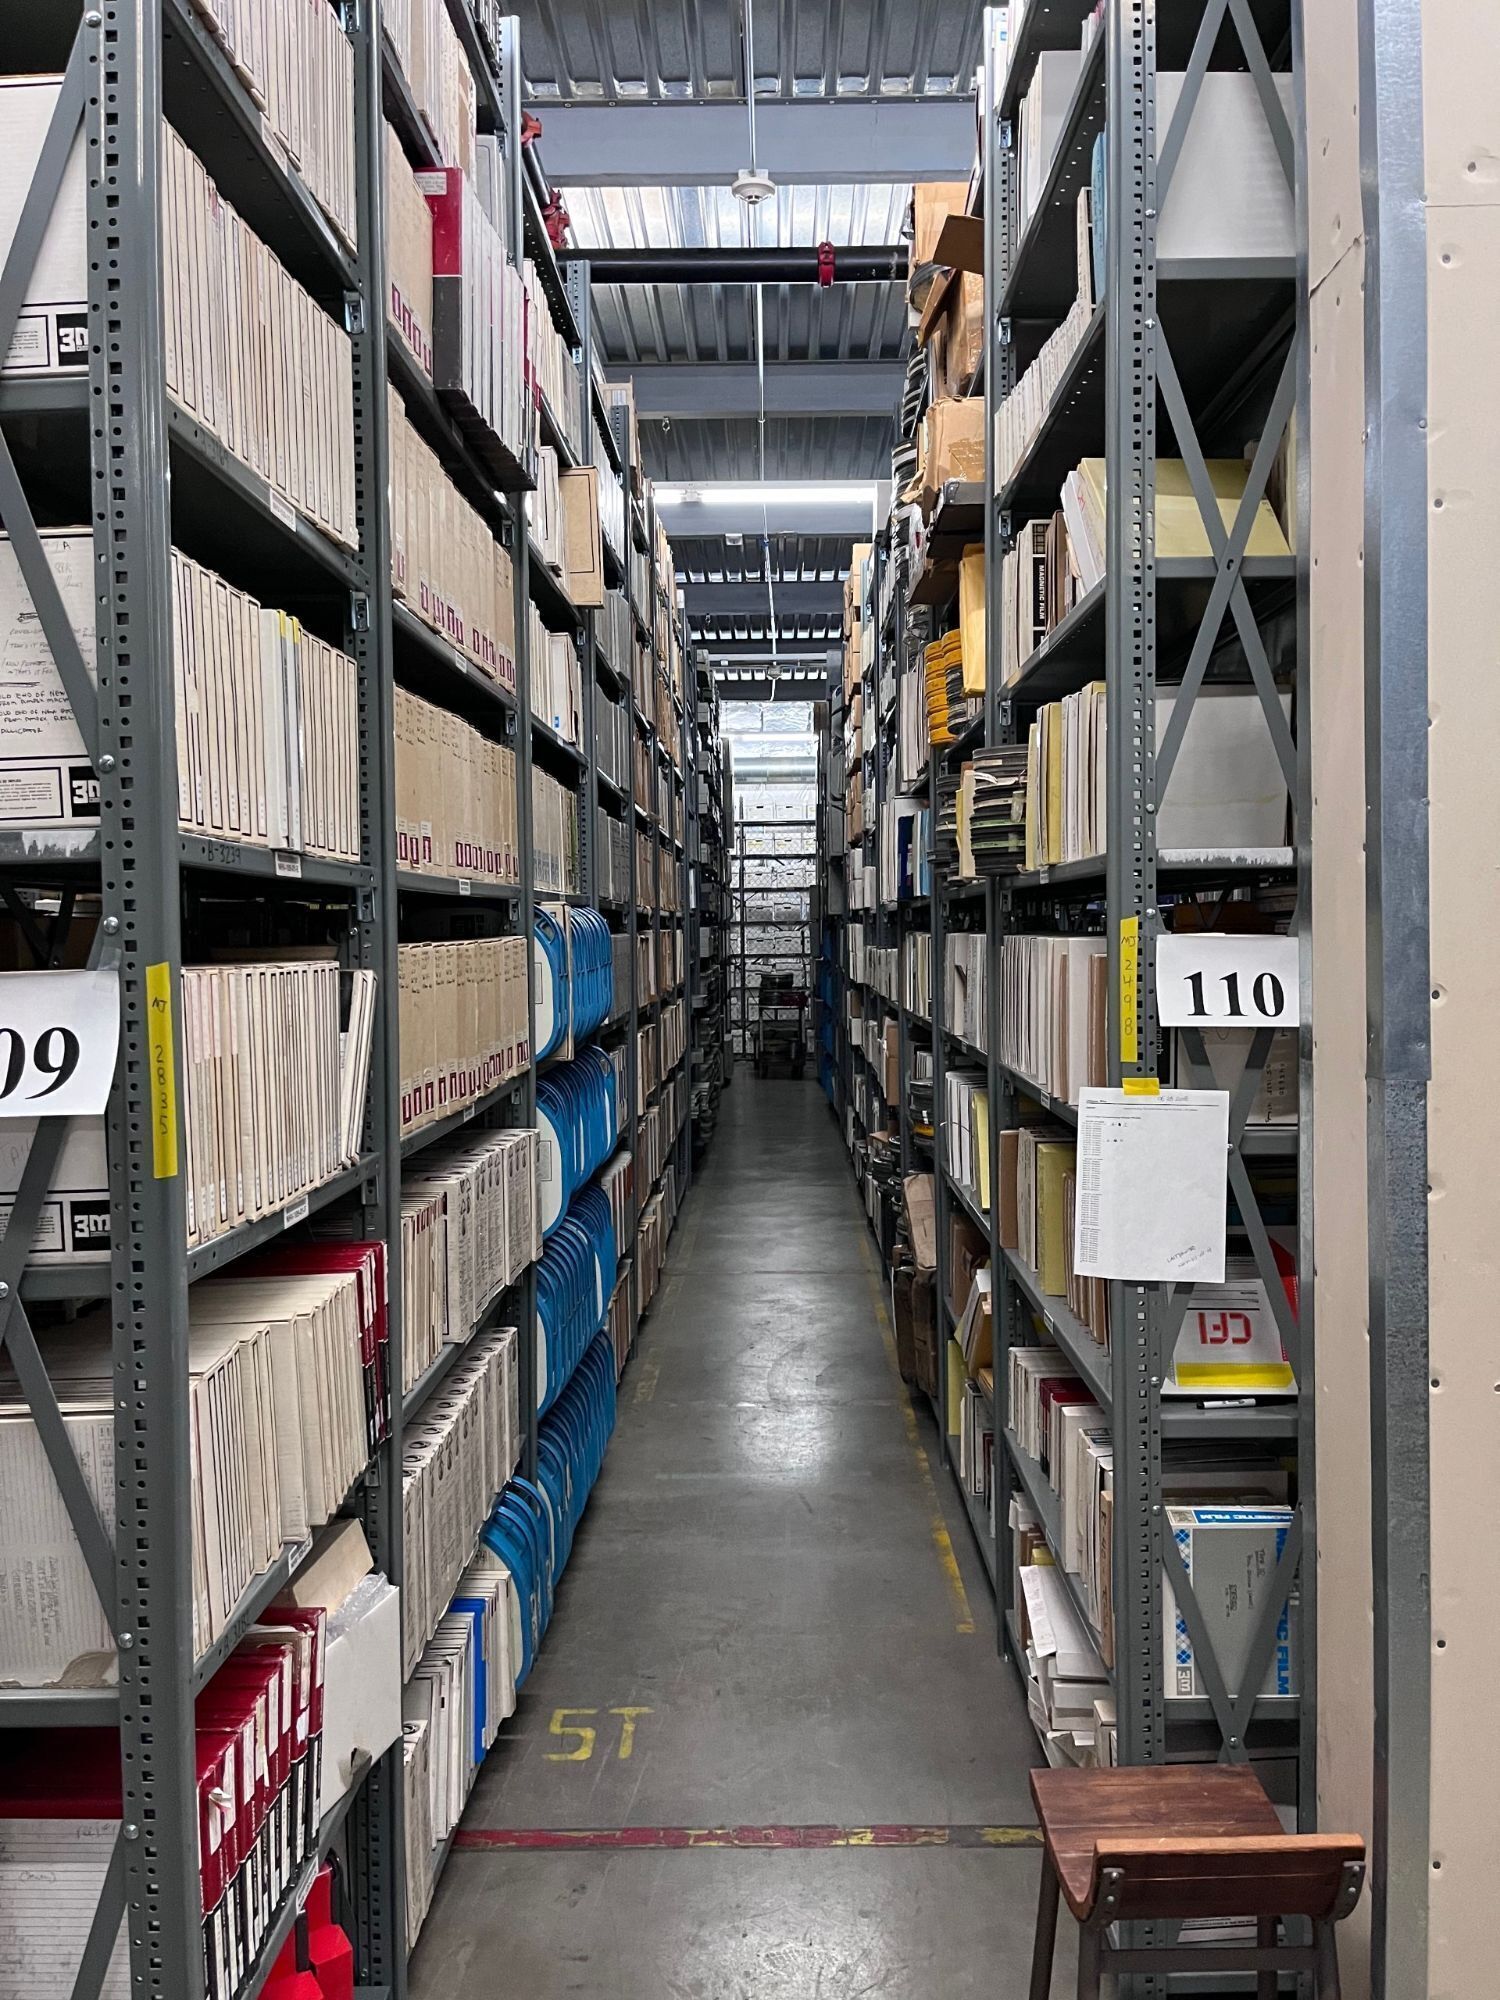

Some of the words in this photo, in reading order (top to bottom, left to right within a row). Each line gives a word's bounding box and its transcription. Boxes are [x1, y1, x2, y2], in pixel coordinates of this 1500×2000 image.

[1123, 959, 1133, 1036] 2498
[1183, 970, 1285, 1018] 110
[1277, 1646, 1289, 1695] FILM
